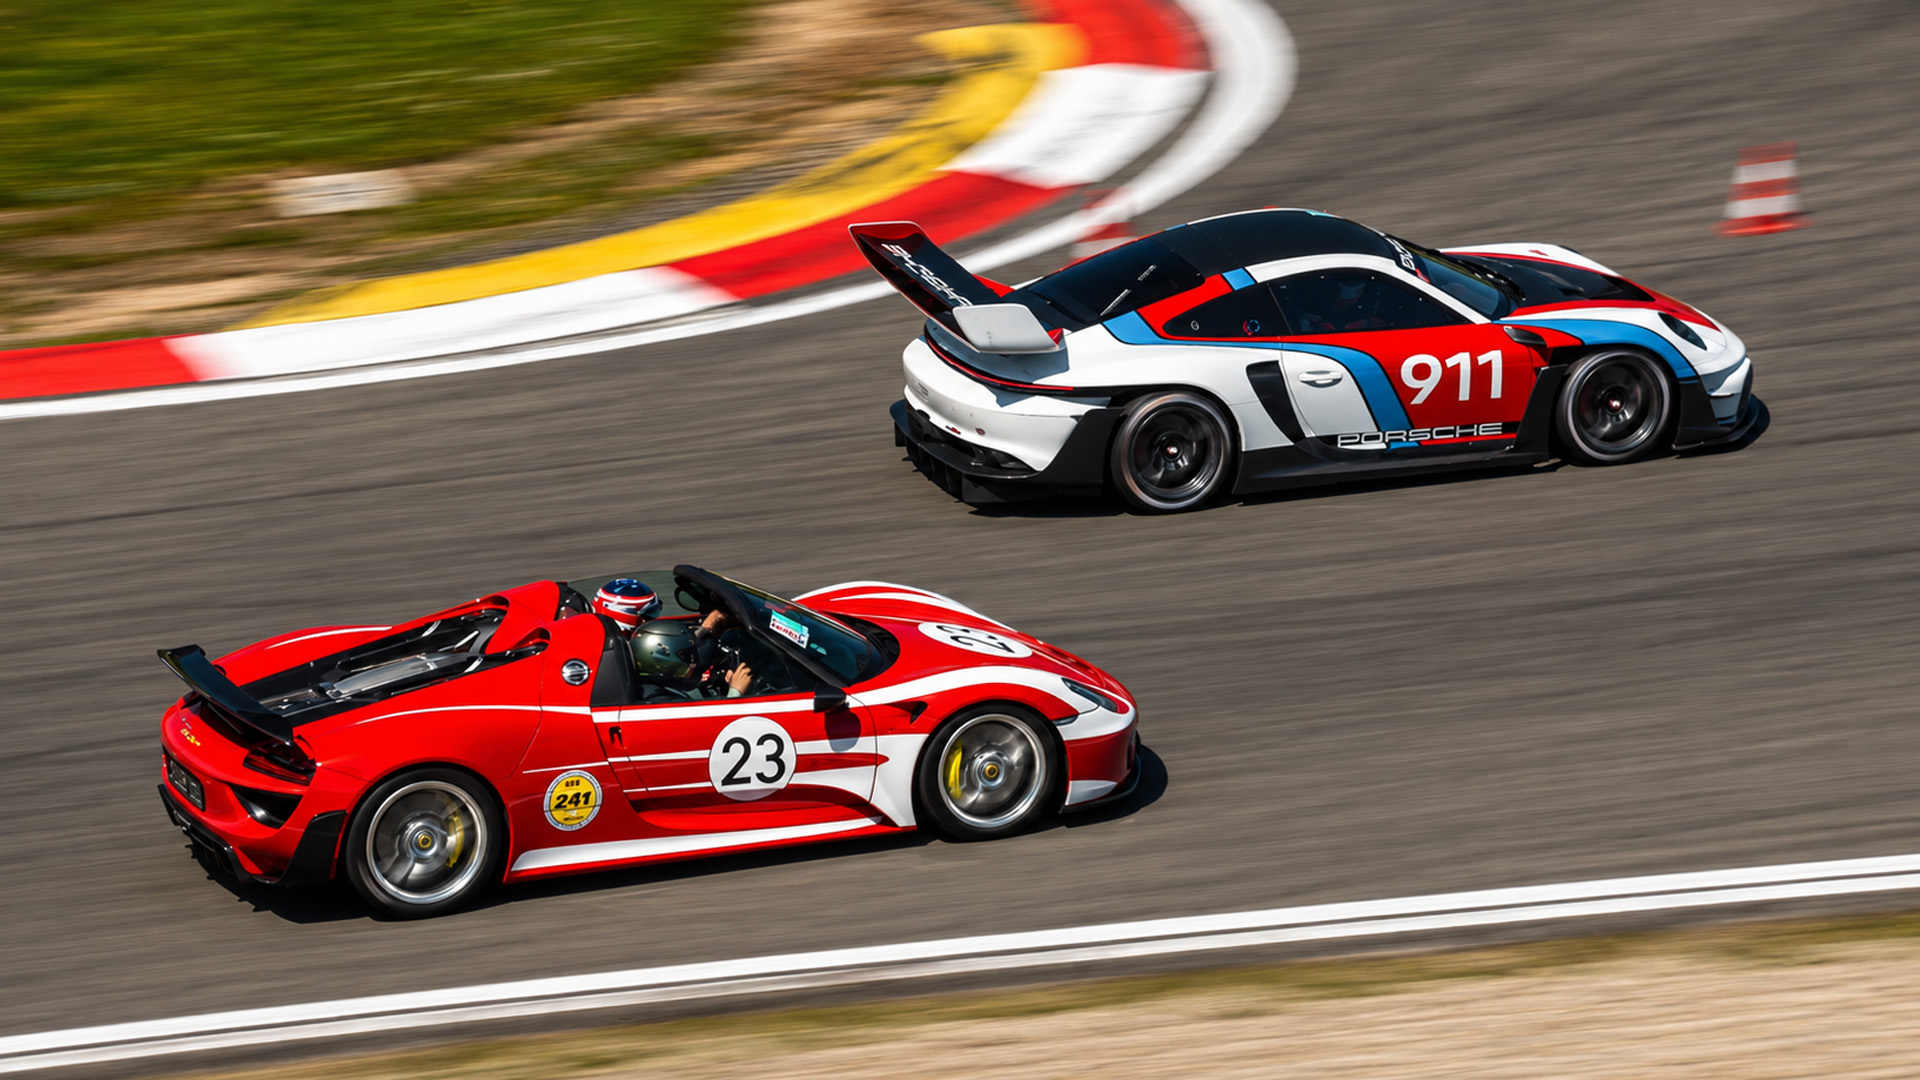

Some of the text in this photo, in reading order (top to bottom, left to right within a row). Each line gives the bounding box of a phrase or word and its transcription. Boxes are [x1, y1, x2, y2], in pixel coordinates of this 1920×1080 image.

[1401, 349, 1503, 405] 911
[1337, 422, 1503, 448] PORSCHE
[721, 733, 786, 786] 23
[554, 791, 592, 809] 241
